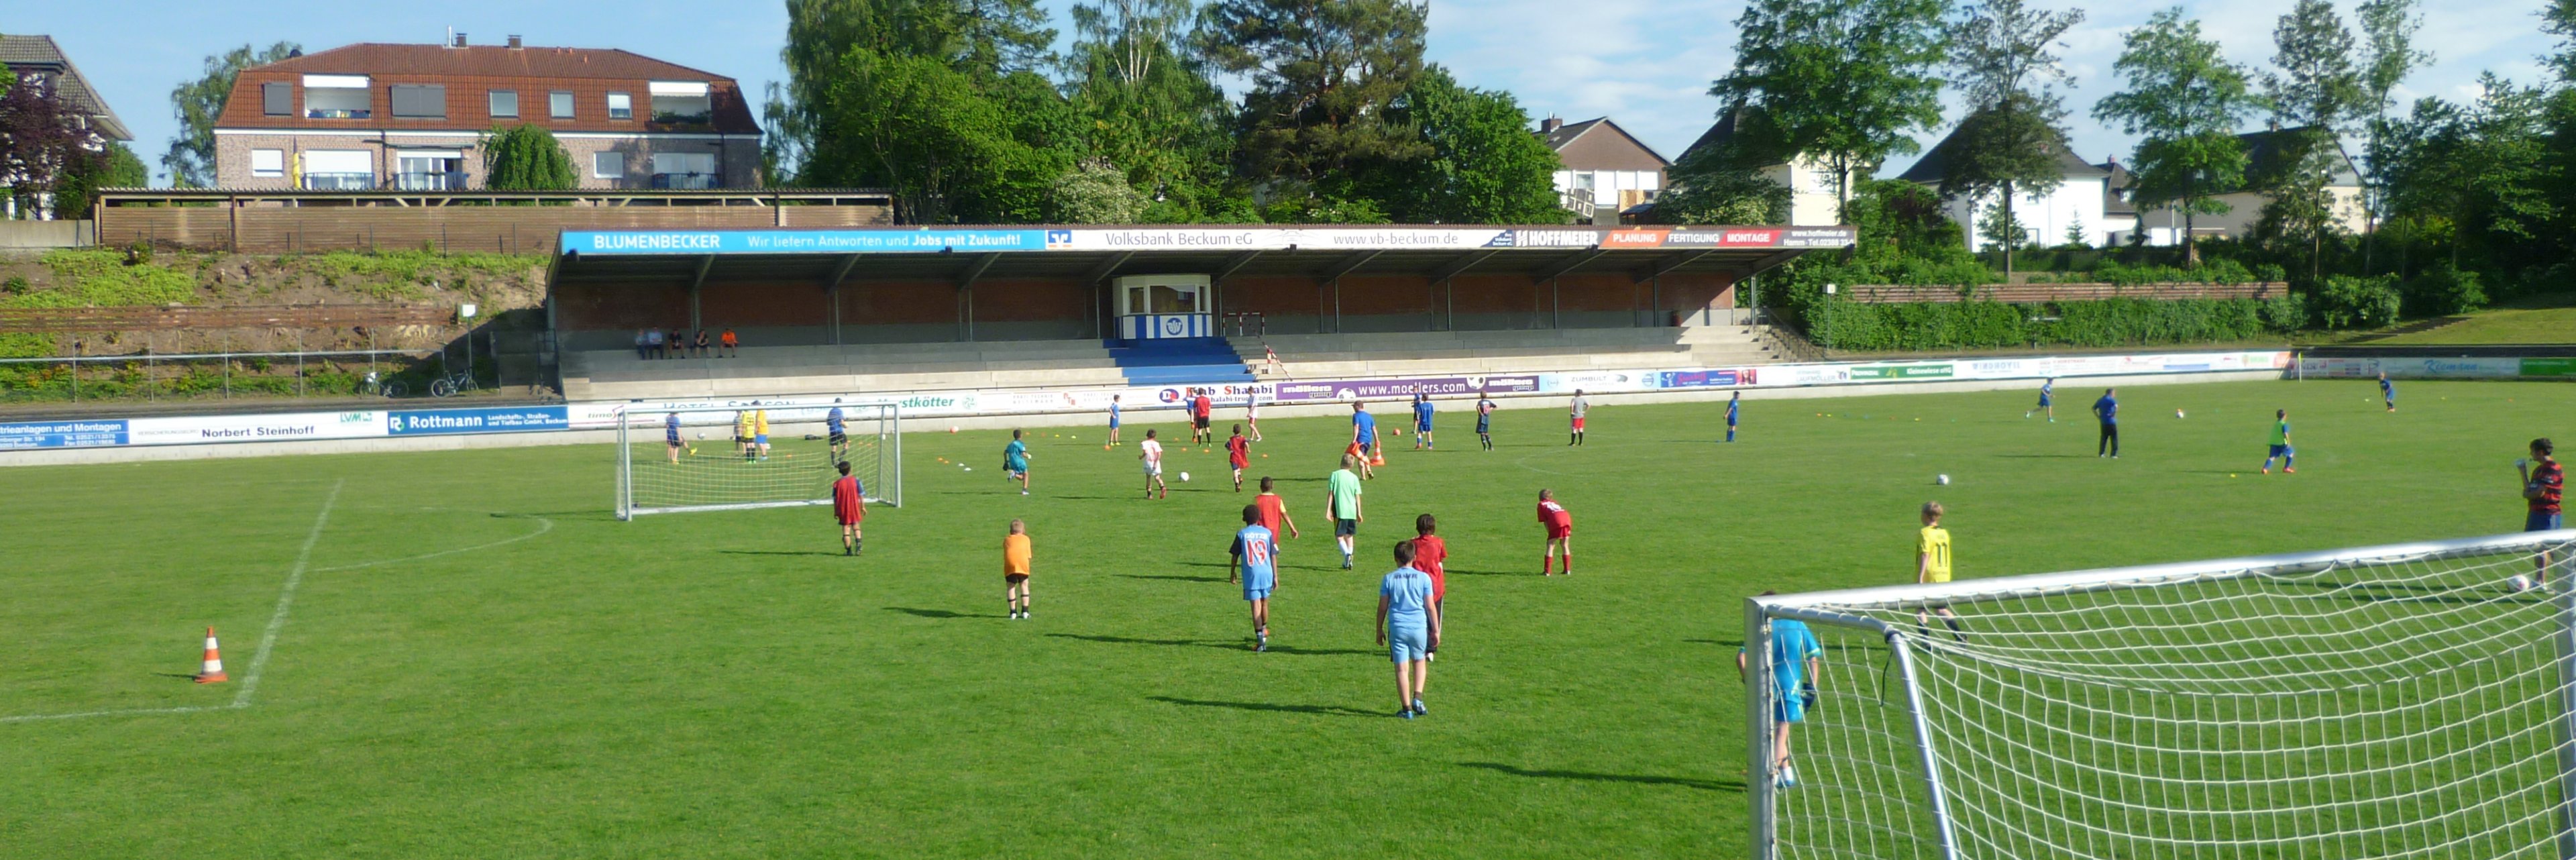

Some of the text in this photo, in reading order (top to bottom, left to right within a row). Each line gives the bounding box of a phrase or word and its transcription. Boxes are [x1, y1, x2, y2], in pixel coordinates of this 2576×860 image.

[594, 233, 1020, 249] BLUMENBECKER Wir liefern Antworten und Jobs mit Zukunft!
[1106, 233, 1252, 246] Volksbank Beckum eG
[1334, 232, 1458, 245] www.vb-beckum.de
[1529, 230, 1598, 247] HOFFMEIER
[1613, 233, 1770, 243] PLANUNG FERTIGUNG MONTAGE
[1224, 385, 1273, 395] Shaabi
[340, 413, 362, 423] LVM
[410, 415, 482, 428] Rottmann
[54, 425, 72, 433] und
[74, 423, 121, 433] Montagen
[202, 428, 251, 437] Norbert
[257, 425, 315, 436] Steinhoff
[1246, 539, 1267, 567] 19
[1935, 542, 1947, 568] 11
